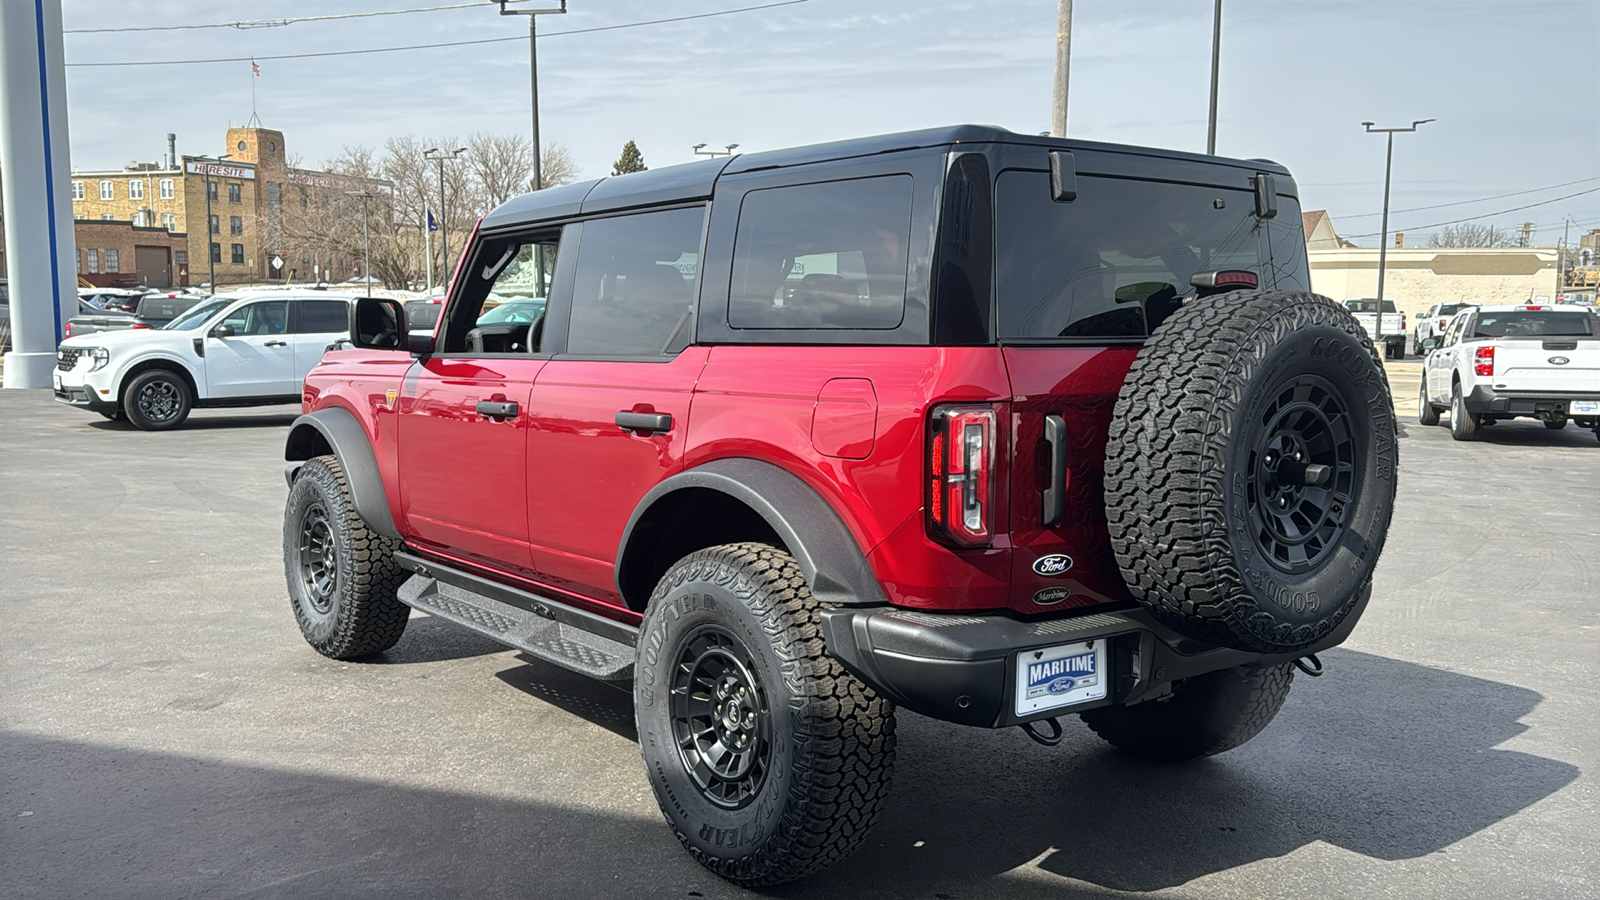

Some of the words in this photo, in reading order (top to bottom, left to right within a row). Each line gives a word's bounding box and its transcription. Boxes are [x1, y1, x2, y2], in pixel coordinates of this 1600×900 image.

[1310, 336, 1392, 481] GOODYEAR
[1040, 557, 1067, 572] Ford
[1037, 589, 1067, 601] Maritime
[641, 593, 717, 707] GOODYEAR
[1030, 654, 1095, 685] MARITIME
[1051, 680, 1071, 692] Ford
